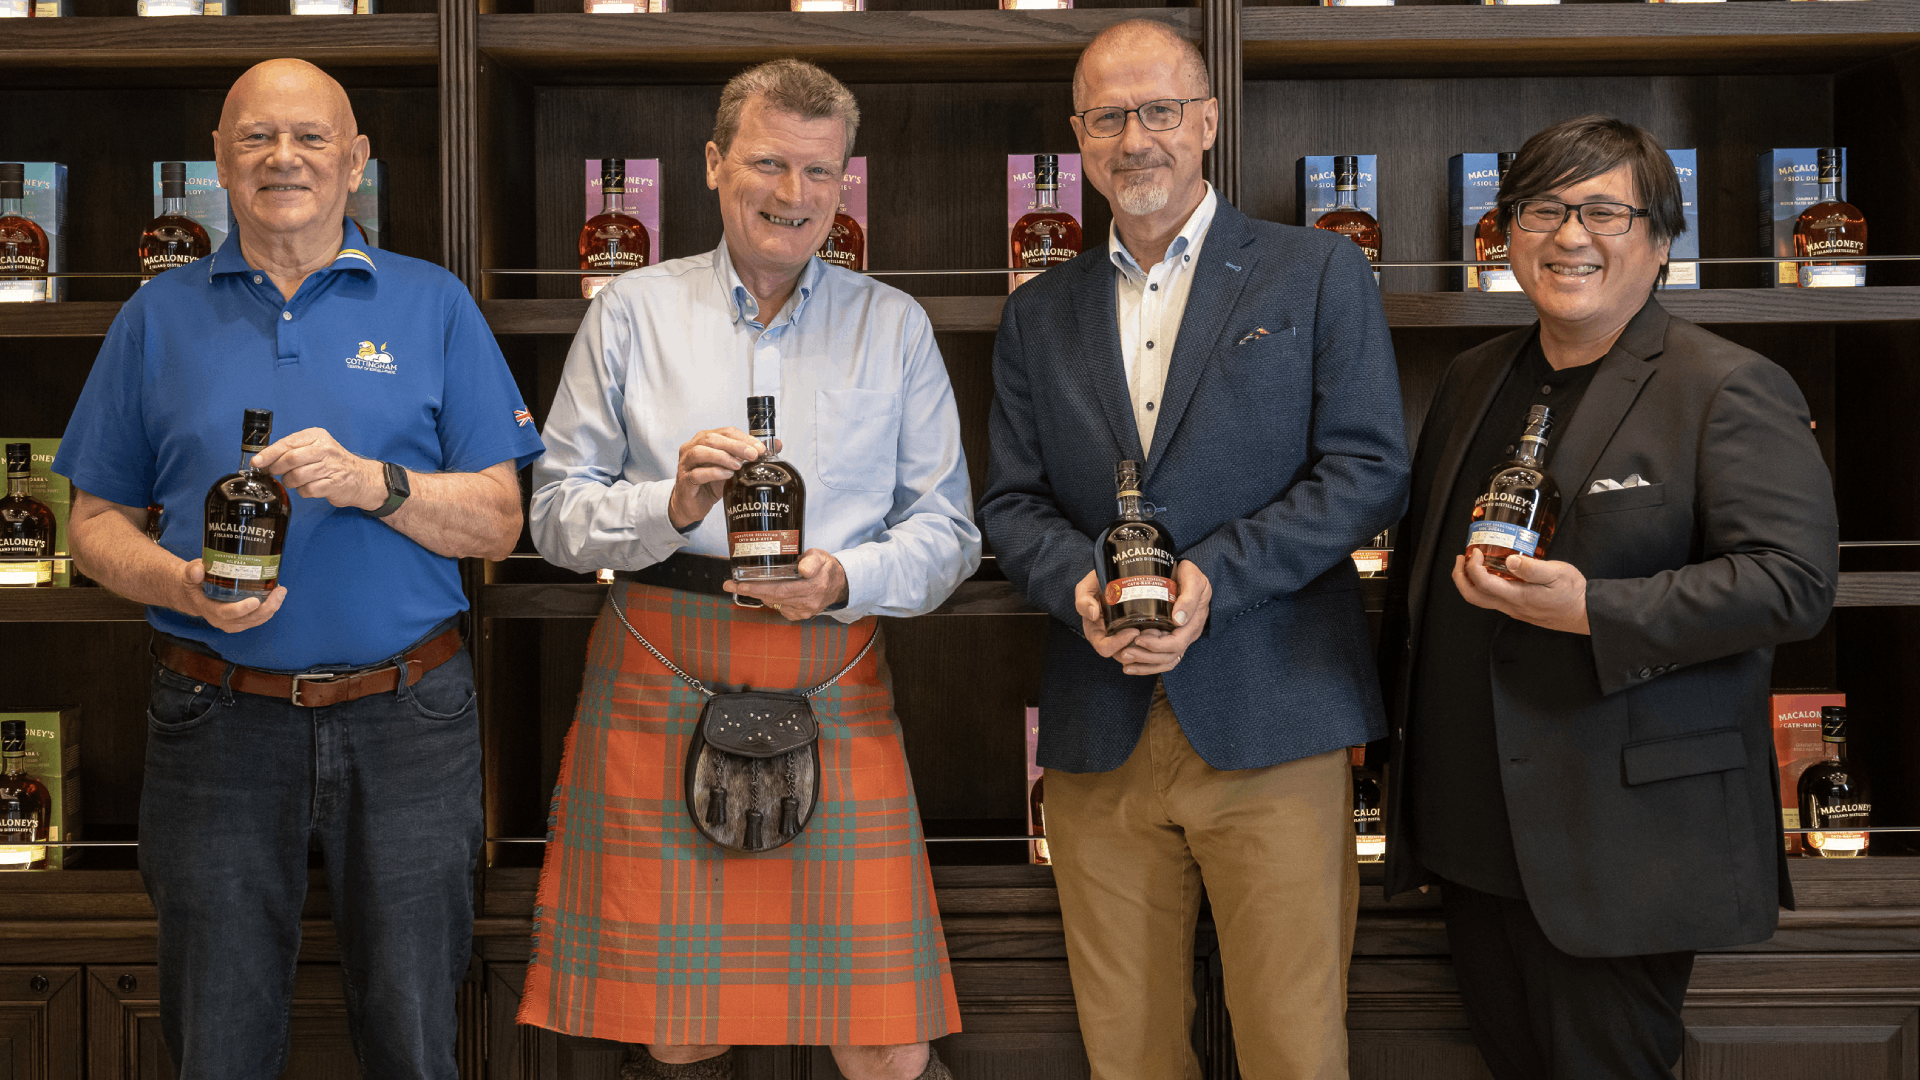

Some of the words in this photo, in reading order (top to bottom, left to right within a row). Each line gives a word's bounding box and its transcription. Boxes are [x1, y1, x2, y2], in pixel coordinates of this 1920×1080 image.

[1778, 164, 1818, 175] MACALO
[1806, 239, 1864, 252] MACALONEY'S
[0, 255, 45, 268] CALONEY'S
[587, 251, 644, 263] MACALONEY'S
[815, 250, 856, 262] ALONEY'S
[345, 357, 398, 371] COTTINGHAM
[727, 501, 790, 516] MACALONEY'S
[1474, 492, 1535, 513] MACALONEY'S
[208, 522, 276, 539] MACALONEY'S
[0, 537, 46, 548] CALONEY'S
[1112, 546, 1175, 565] MACALONEY'S
[1778, 710, 1822, 722] MACALON
[1820, 803, 1872, 816] MACALONEY'S
